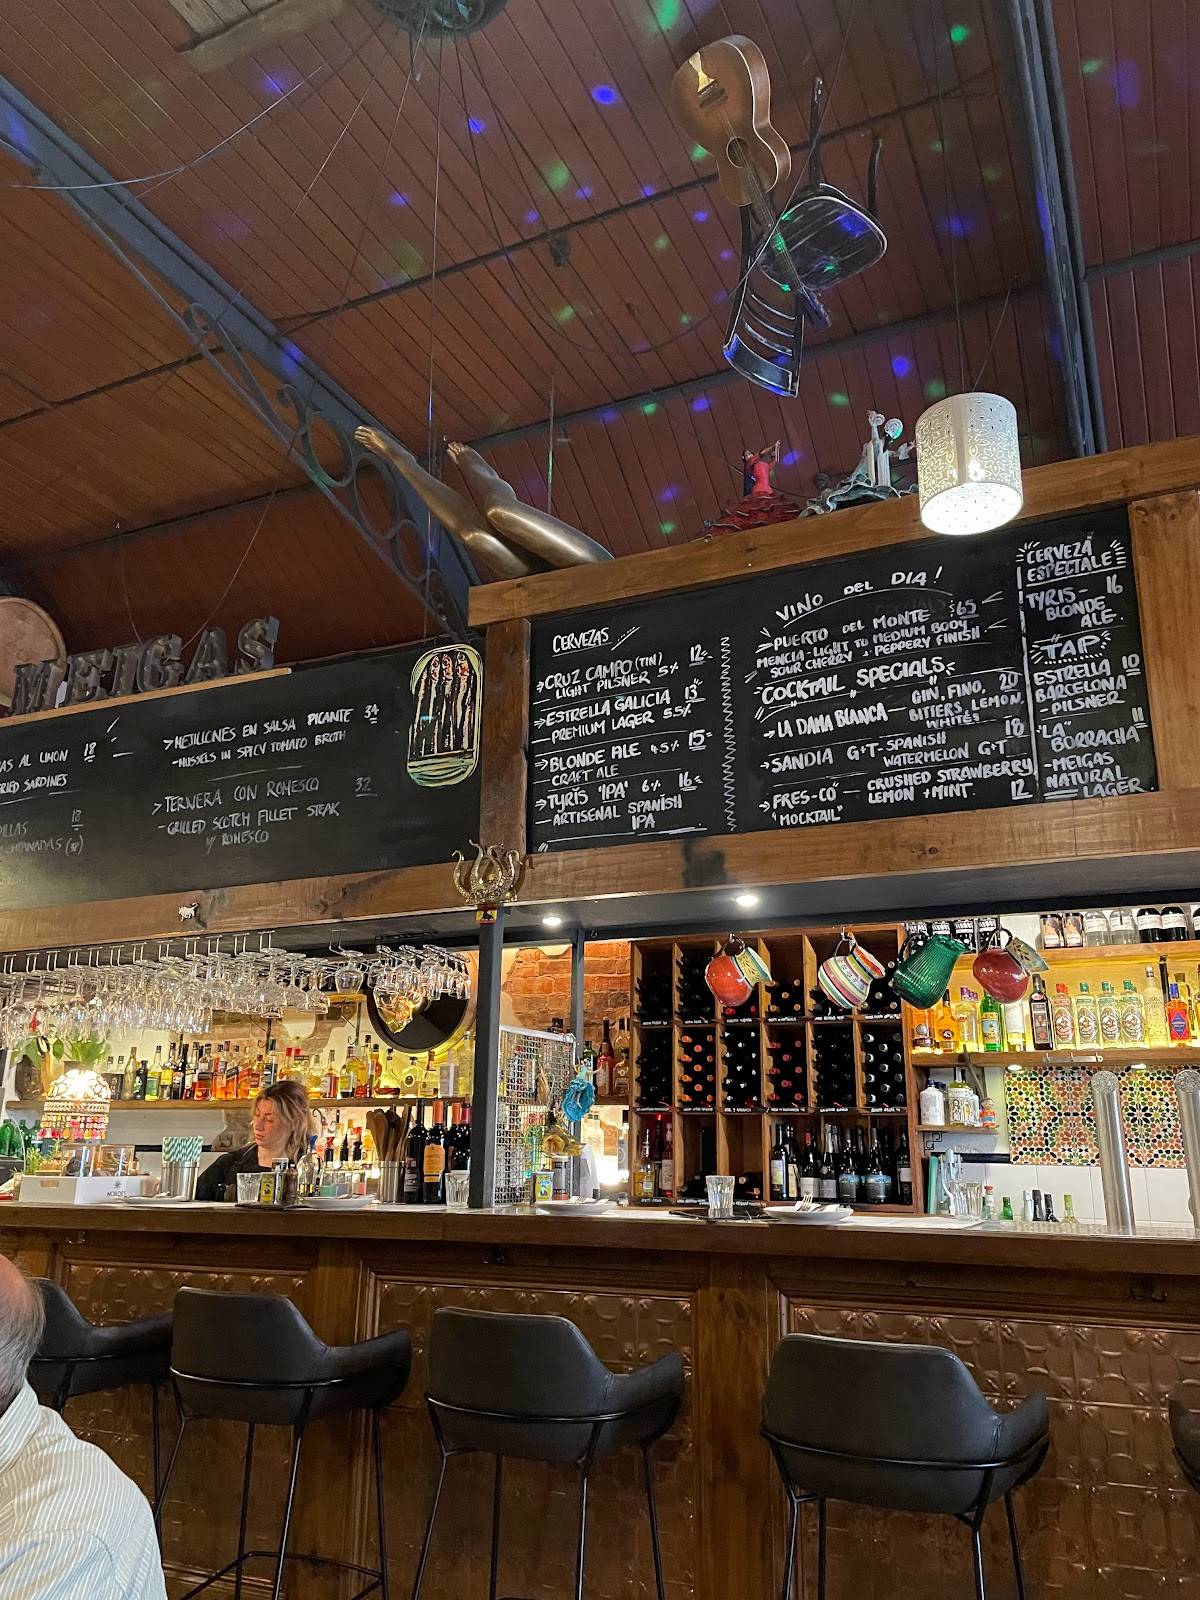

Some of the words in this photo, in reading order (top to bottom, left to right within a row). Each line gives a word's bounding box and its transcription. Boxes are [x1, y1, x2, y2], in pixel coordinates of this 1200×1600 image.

[1027, 539, 1092, 564] CERVEZA
[844, 581, 873, 596] DEL
[1026, 587, 1076, 612] TYRIS
[1106, 574, 1123, 594] 16
[1046, 596, 1106, 621] BLONDE
[552, 627, 609, 652] CERVEZAS
[774, 628, 829, 650] PUERTO
[842, 620, 865, 634] DEL
[874, 609, 932, 629] MONTE
[873, 624, 925, 644] MEDIUM
[931, 620, 967, 635] BODY
[770, 661, 801, 678] SOUR
[805, 650, 852, 670] CHERRY
[875, 636, 930, 656] PEPPERY
[1040, 635, 1100, 659] TAP
[8, 616, 279, 715] MEIGAS
[545, 669, 580, 690] CRUZ
[586, 659, 633, 682] CAMPO
[1033, 659, 1111, 686] ESTRELLA
[1122, 654, 1139, 668] 10
[556, 683, 590, 699] LIGHT
[597, 671, 650, 692] PILSNER
[762, 674, 845, 705] COCKTAIL
[856, 657, 945, 688] SPECIALS
[1035, 675, 1126, 704] BARCELONA
[546, 700, 610, 726] ESTRELLA
[615, 689, 670, 711] GALICIA
[777, 719, 792, 738] LA
[837, 702, 888, 728] BLANCA
[999, 674, 1018, 691] 20
[242, 724, 257, 737] EN
[263, 718, 296, 732] SALSA
[308, 709, 354, 725] PICANTE
[364, 704, 379, 718] 34
[551, 720, 605, 744] PREMIUM
[612, 711, 655, 730] LAGER
[1005, 718, 1024, 736] 18
[221, 750, 231, 760] IN
[237, 744, 265, 758] SPICY
[271, 737, 307, 753] TOMATO
[315, 731, 346, 746] BROTH
[1051, 726, 1139, 752] BORRACHA
[19, 754, 31, 768] AL
[550, 749, 605, 772] BLONDE
[612, 743, 641, 760] ALE
[772, 748, 833, 773] SANDIA
[883, 743, 968, 768] WATERMELON
[23, 774, 68, 792] SARDINES
[552, 768, 593, 786] CRAFT
[597, 764, 619, 778] ALE
[867, 771, 931, 791] CRUSHED
[937, 757, 1033, 781] STRAWBERRY
[1046, 766, 1129, 788] NATURAL
[165, 790, 222, 813] TERNERA
[234, 785, 258, 800] CON
[267, 778, 319, 797] ROMESCO
[355, 778, 371, 792] 32
[868, 785, 914, 803] LEMON
[1011, 779, 1029, 796] 12
[212, 813, 249, 830] SCOTCH
[258, 808, 298, 826] FILLET
[307, 802, 340, 817] STEAK
[552, 805, 621, 826] ARTISENAL
[628, 794, 682, 814] SPANISH
[632, 815, 655, 829] IPA
